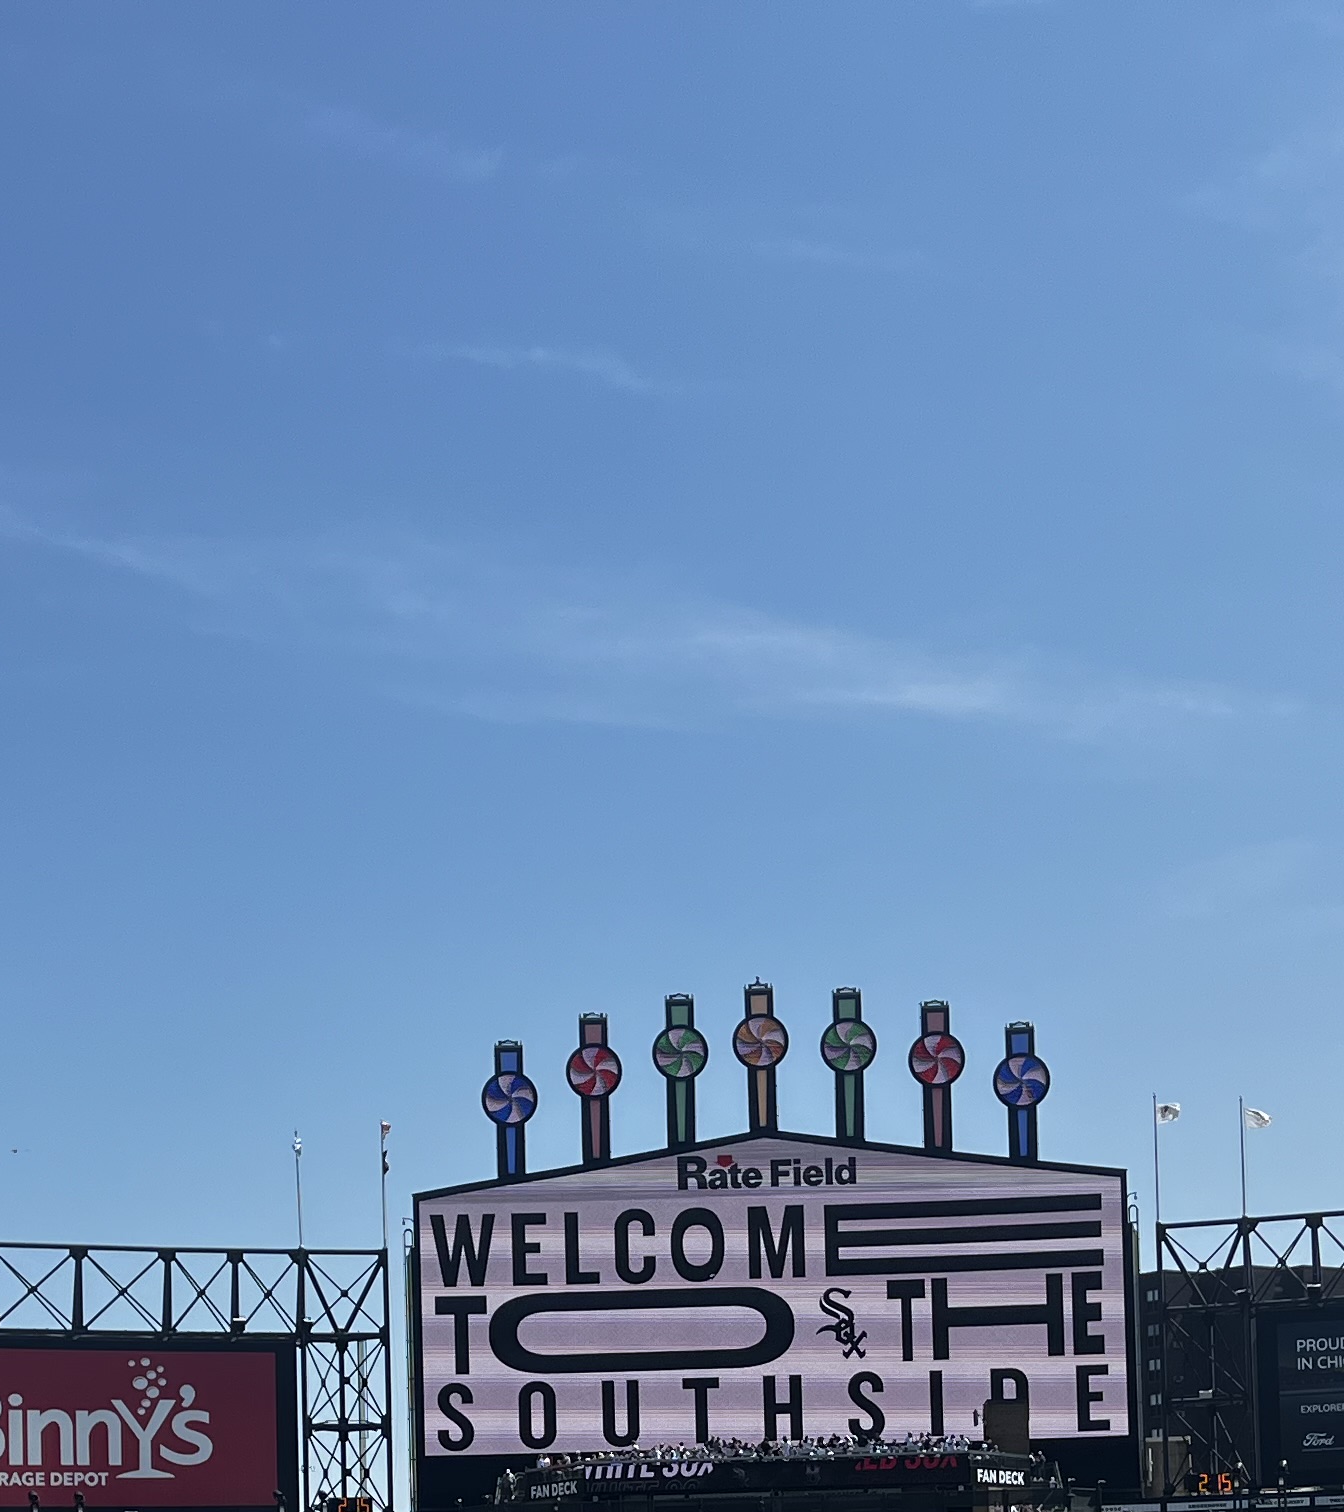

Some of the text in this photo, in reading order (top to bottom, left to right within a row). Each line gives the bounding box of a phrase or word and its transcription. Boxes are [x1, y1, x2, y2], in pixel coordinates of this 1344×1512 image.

[677, 1156, 856, 1190] Rate Field
[430, 1194, 1104, 1288] WELCOME
[435, 1286, 795, 1375] TO
[887, 1271, 1106, 1361] THE
[1297, 1357, 1313, 1370] IN
[1303, 1433, 1335, 1447] Ford
[50, 1472, 108, 1487] DEPOT
[977, 1469, 1025, 1486] FAN DECK
[531, 1485, 550, 1499] FAN
[551, 1481, 578, 1496] DECK
